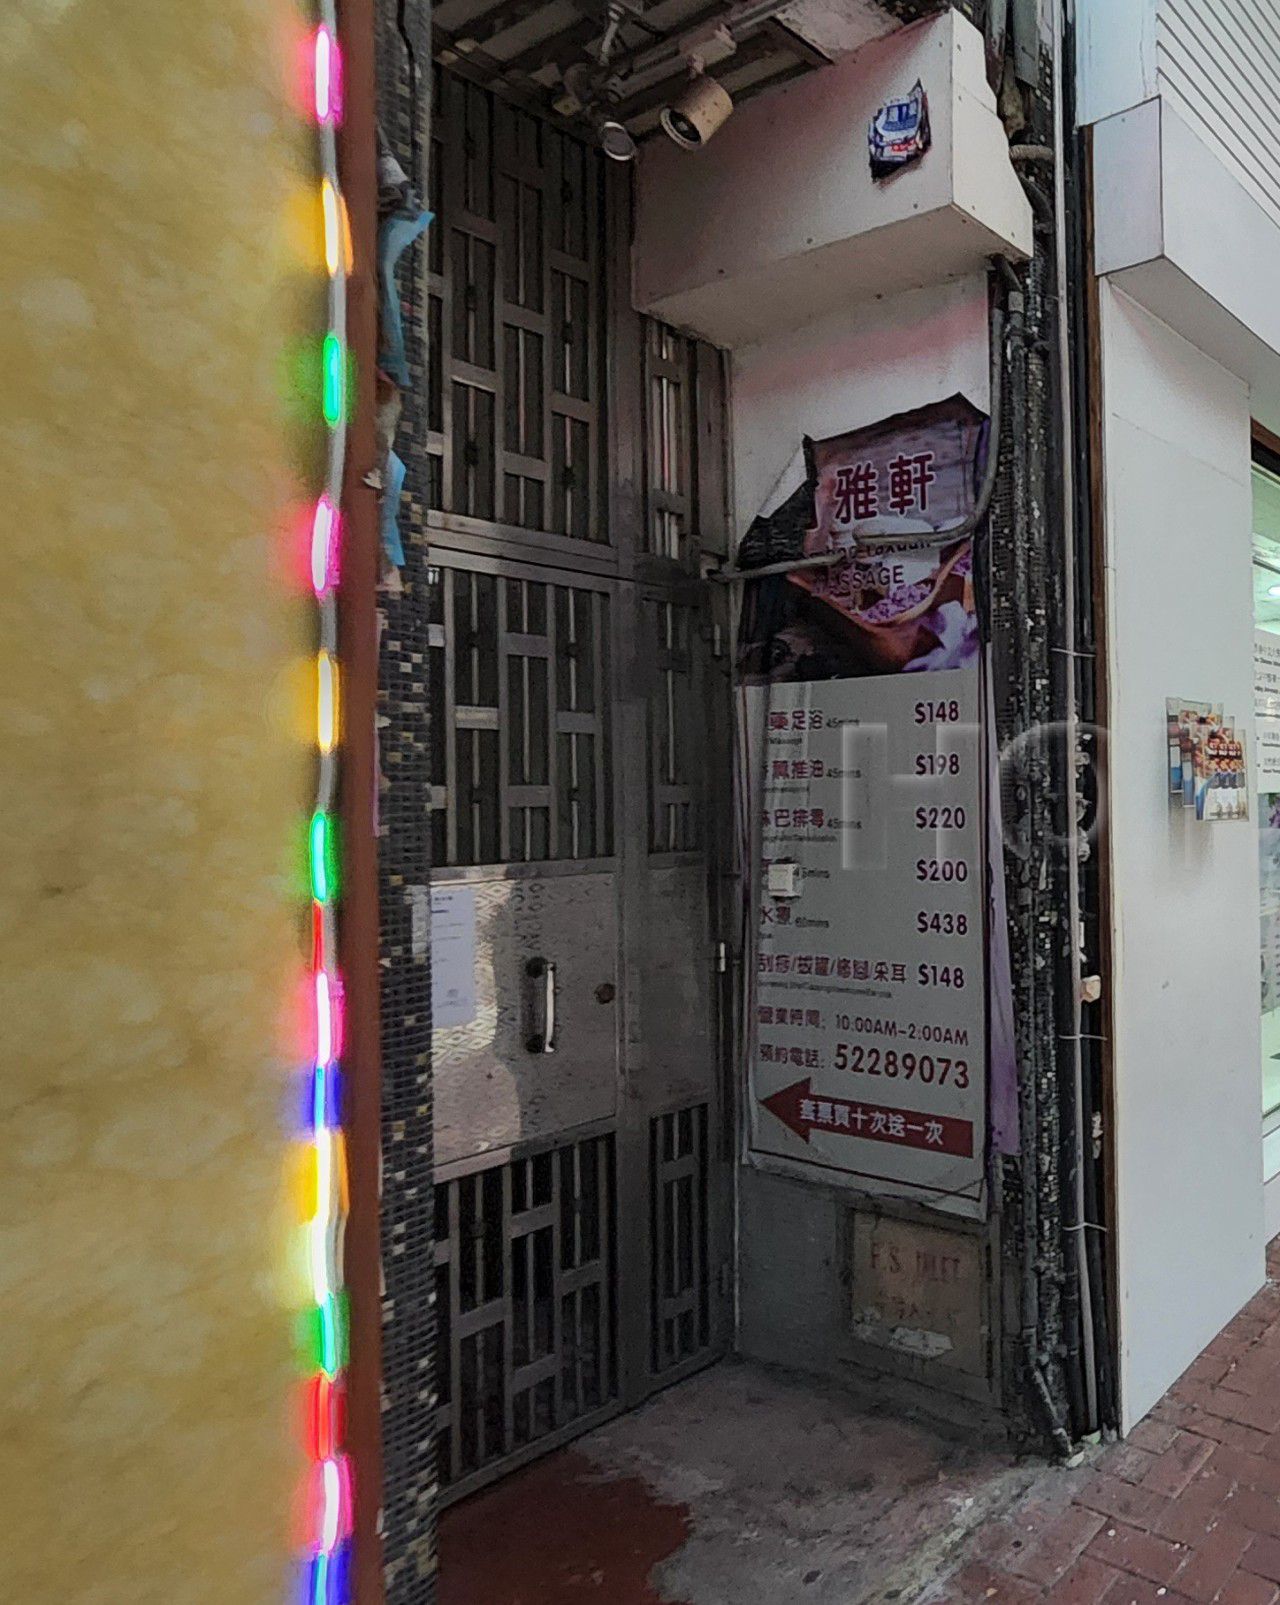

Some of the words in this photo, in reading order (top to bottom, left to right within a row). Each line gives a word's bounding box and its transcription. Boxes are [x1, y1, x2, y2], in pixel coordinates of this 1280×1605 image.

[834, 453, 936, 524] 雅軒
[914, 700, 959, 724] $148
[915, 753, 960, 775] $198
[915, 806, 966, 829] $220
[916, 859, 968, 882] $200
[917, 911, 968, 936] $438
[918, 963, 965, 989] $148
[834, 1043, 970, 1090] 52289073
